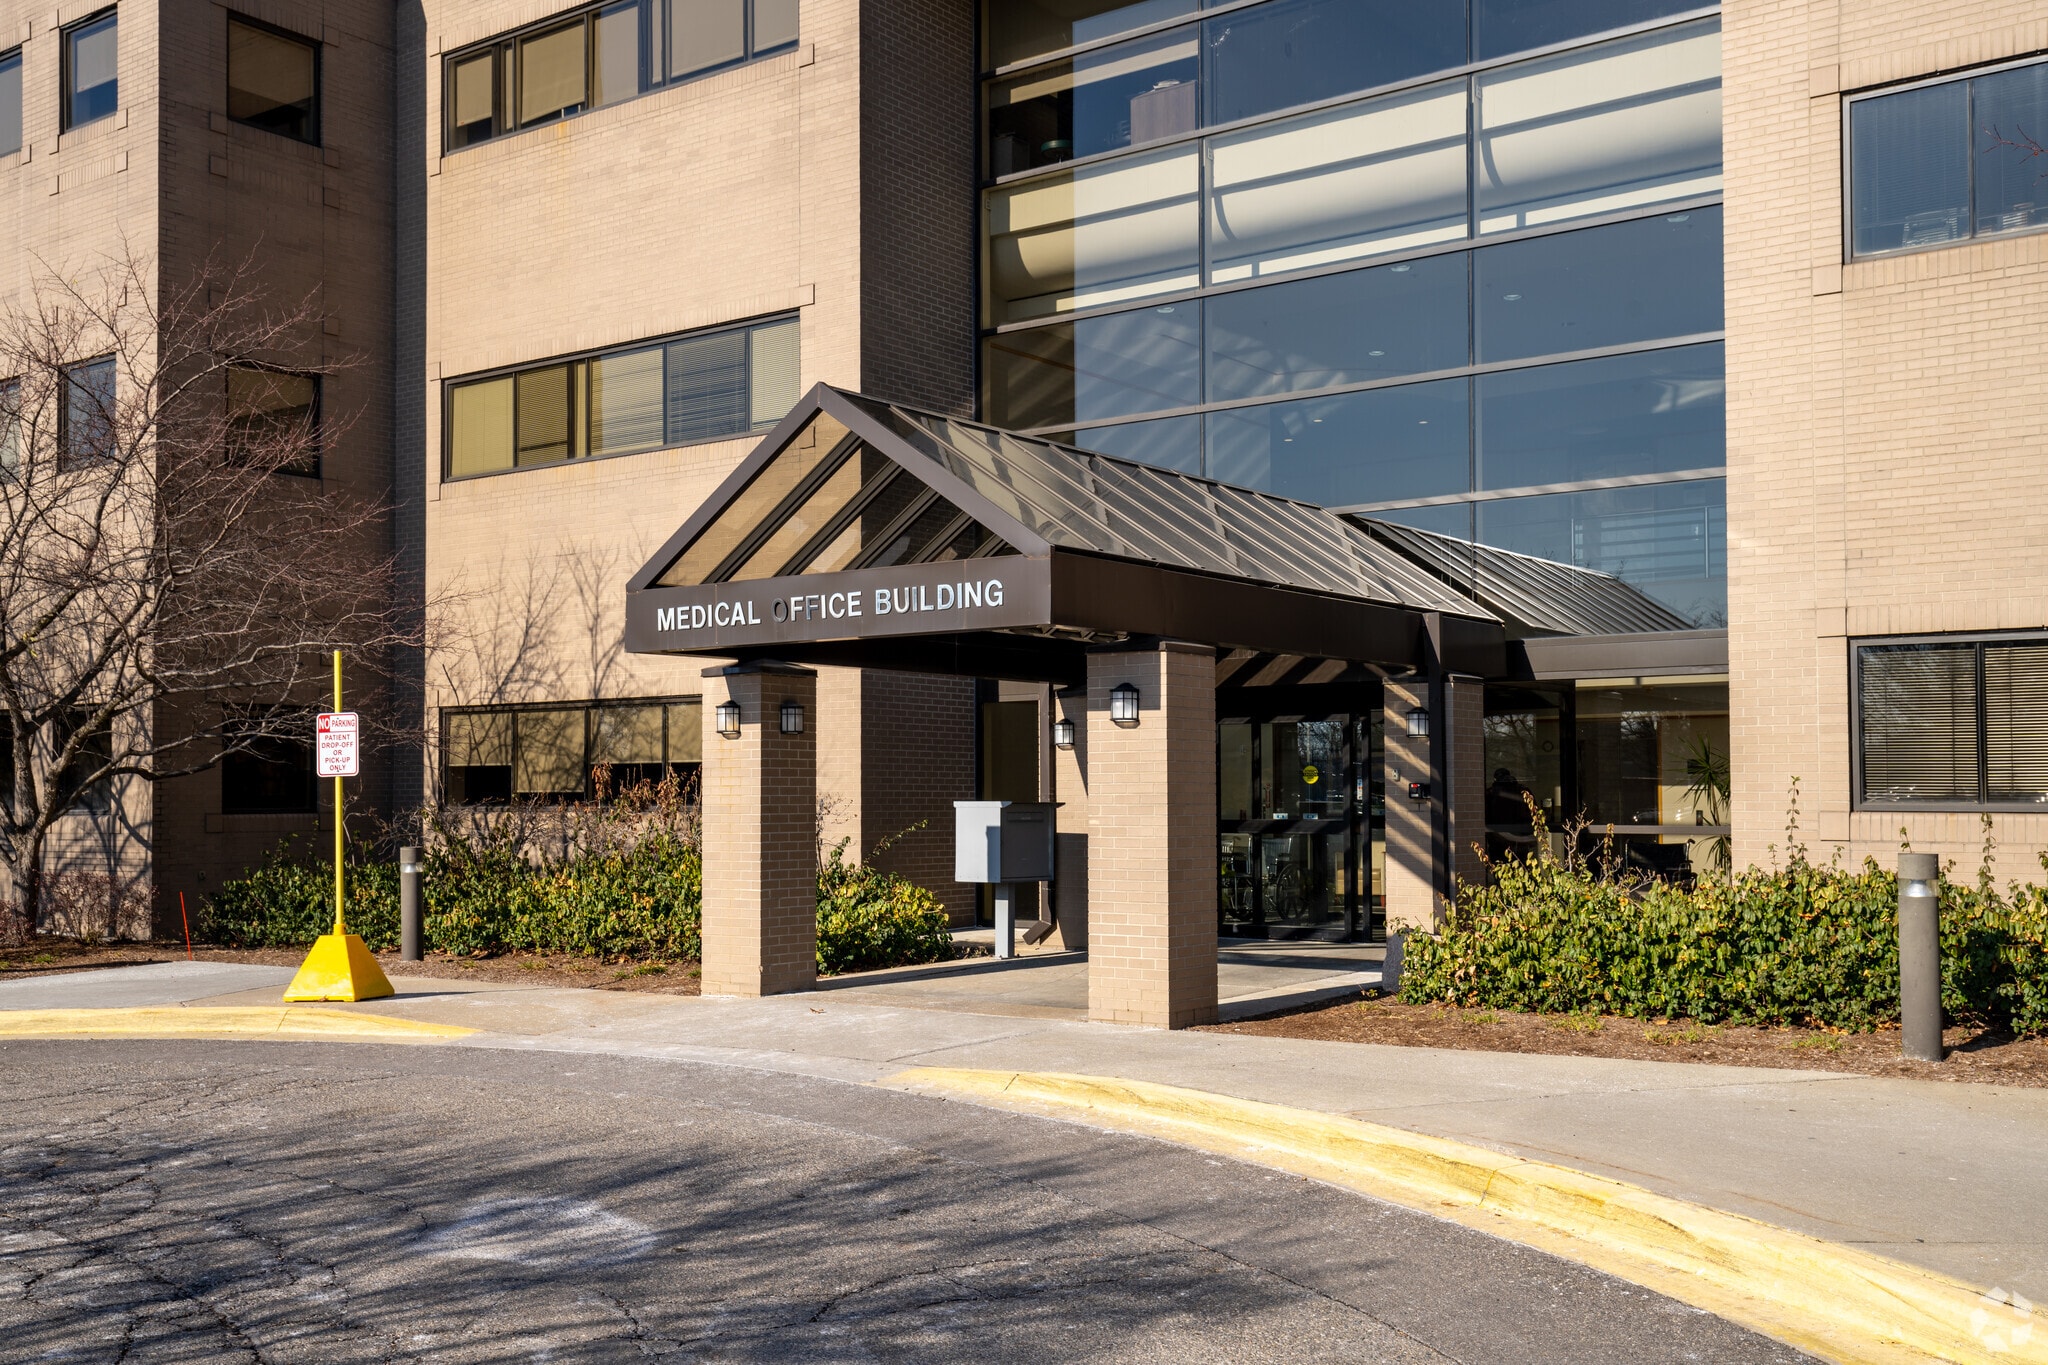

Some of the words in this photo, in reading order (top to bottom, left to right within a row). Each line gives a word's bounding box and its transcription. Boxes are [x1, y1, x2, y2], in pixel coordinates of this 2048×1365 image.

[657, 601, 761, 632] MEDICAL
[771, 591, 862, 623] OFFICE
[875, 579, 1004, 615] BUILDING
[319, 718, 330, 730] NO
[332, 719, 355, 727] PARKING
